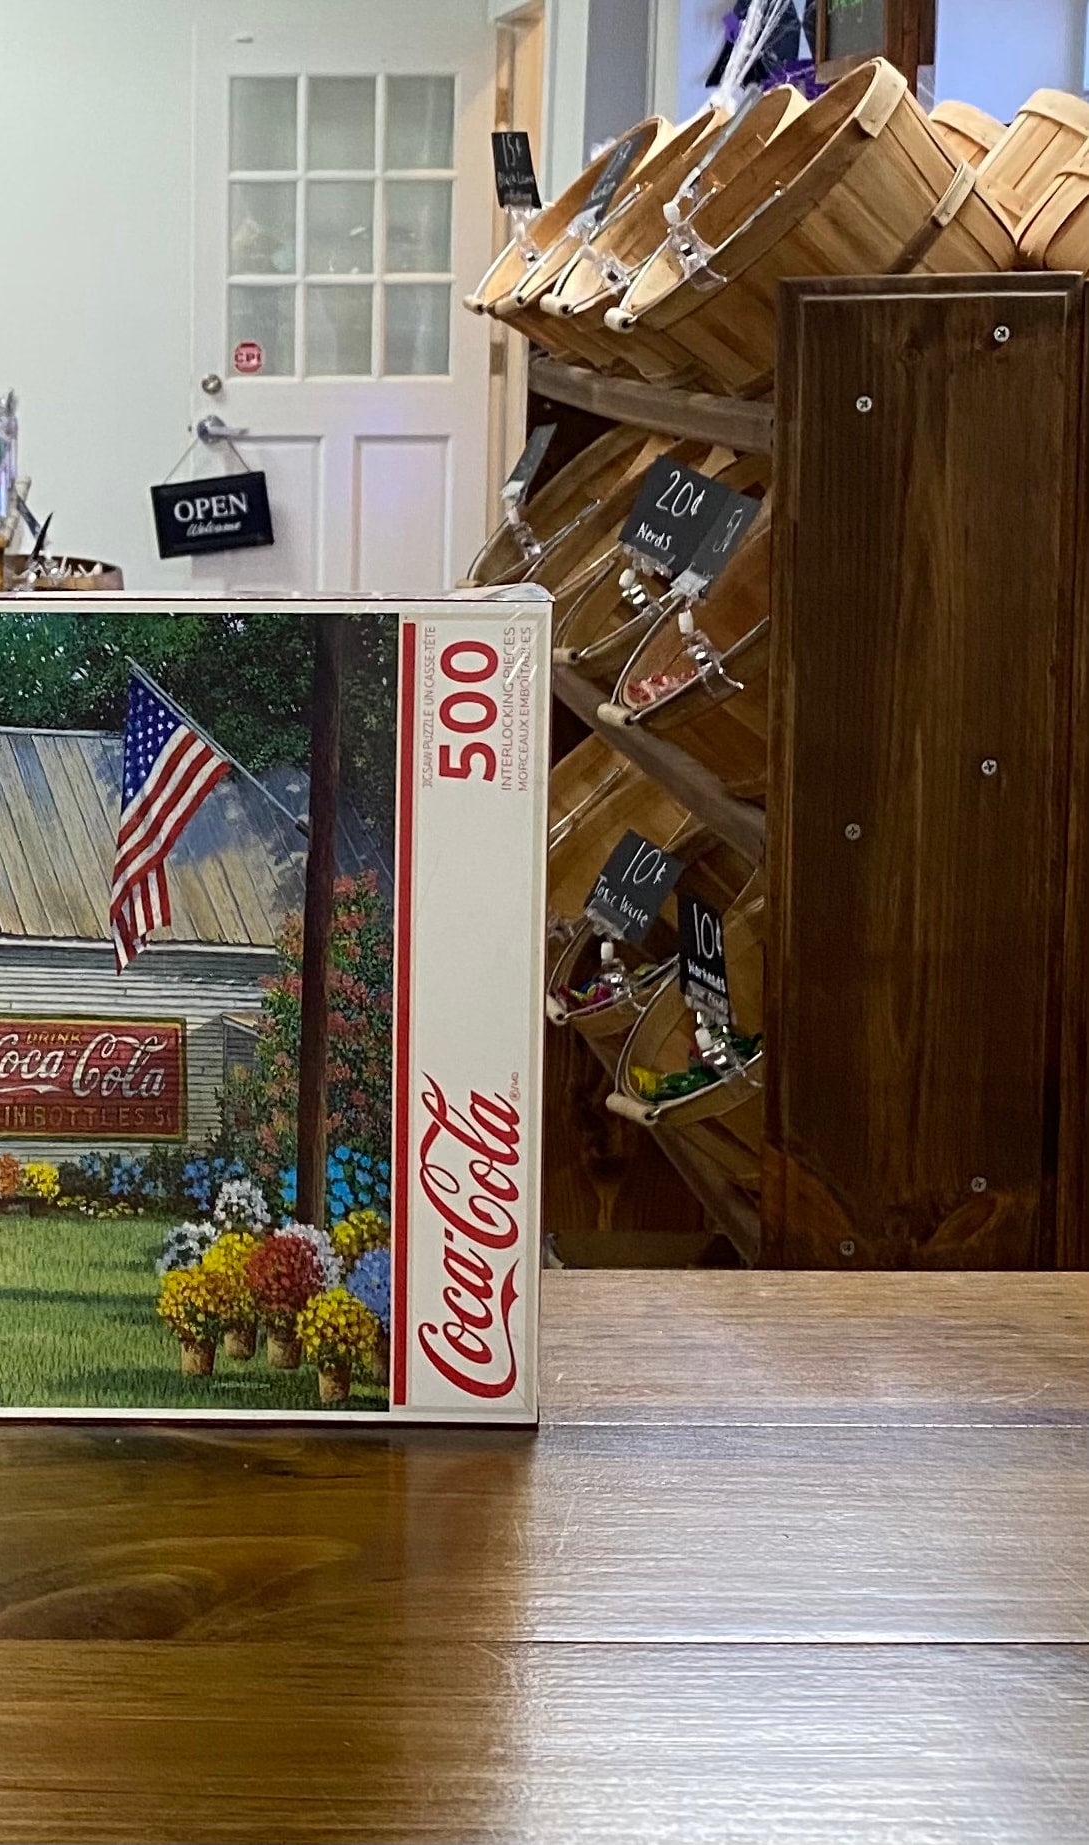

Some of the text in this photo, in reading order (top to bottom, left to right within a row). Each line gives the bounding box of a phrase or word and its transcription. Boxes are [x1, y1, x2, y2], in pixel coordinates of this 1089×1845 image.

[173, 492, 249, 522] OPEN
[656, 470, 706, 518] 20¢
[186, 519, 242, 537] Welcome
[425, 690, 435, 706] UN
[439, 641, 498, 782] 500
[501, 626, 516, 791] INTERLOCKING PIECES
[423, 709, 434, 750] PUZZLE
[422, 751, 433, 789] JIGSAW
[518, 720, 530, 792] MORCEAUX
[621, 841, 667, 885] 10¢
[26, 1032, 82, 1046] DRINK
[34, 1106, 144, 1128] BOTTLES
[418, 1071, 520, 1398] Coca-Cola
